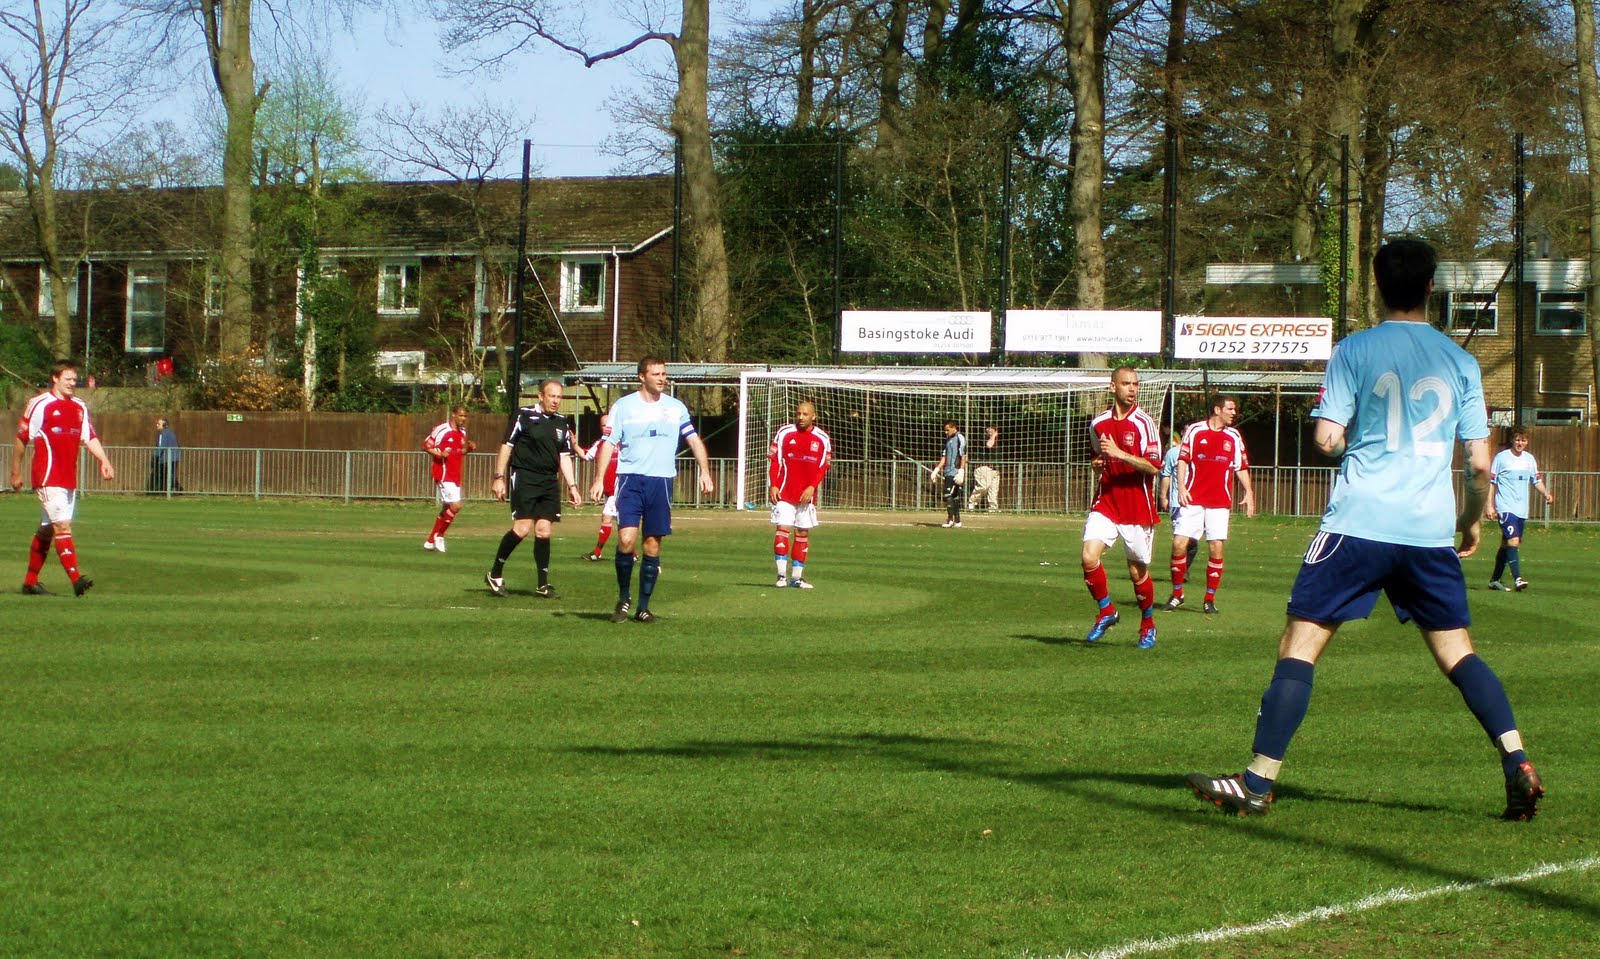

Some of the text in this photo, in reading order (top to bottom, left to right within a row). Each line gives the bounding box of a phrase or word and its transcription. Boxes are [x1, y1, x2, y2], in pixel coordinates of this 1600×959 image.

[1058, 312, 1106, 329] Tamar
[858, 327, 974, 342] Basingstoke Audi
[1195, 323, 1329, 337] SIGNS EXPRESS
[1199, 341, 1310, 354] 01252 377575
[1372, 370, 1453, 457] 12
[1507, 525, 1515, 536] 9
